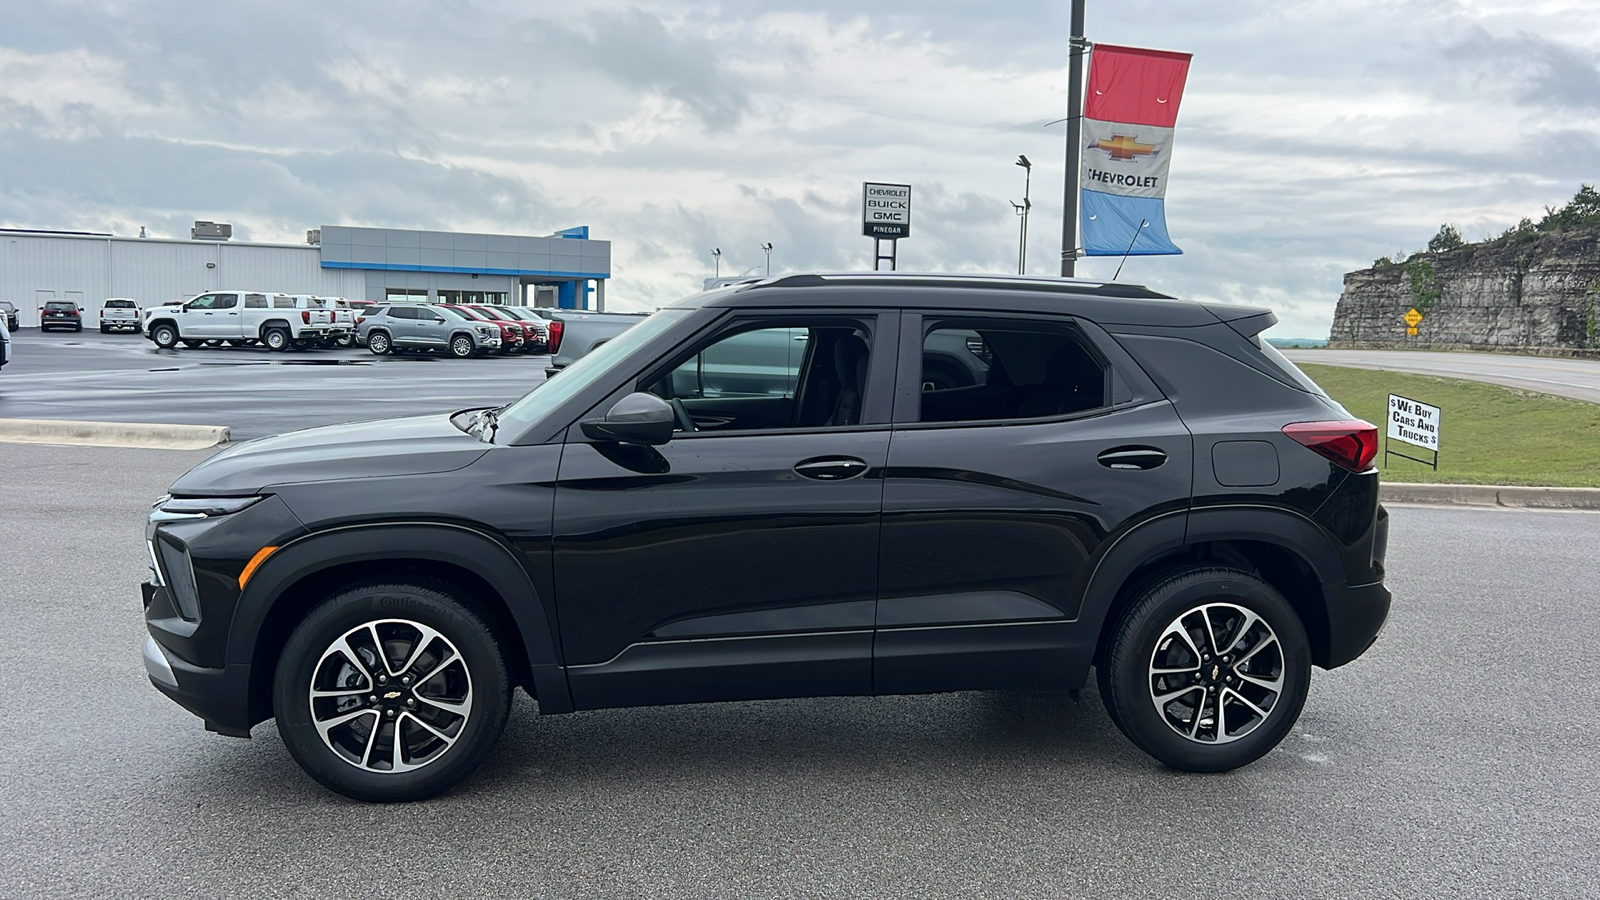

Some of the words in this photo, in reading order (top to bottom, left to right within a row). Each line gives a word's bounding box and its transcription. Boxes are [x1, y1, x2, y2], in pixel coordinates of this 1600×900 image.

[869, 188, 907, 197] CHEVROLET
[868, 200, 907, 209] BUICK
[873, 212, 902, 221] GMC
[873, 226, 901, 234] PINEGAR
[1415, 404, 1432, 419] BUY
[1392, 411, 1415, 427] CARS
[1417, 418, 1435, 433] AND
[1397, 424, 1429, 444] TRUCKS
